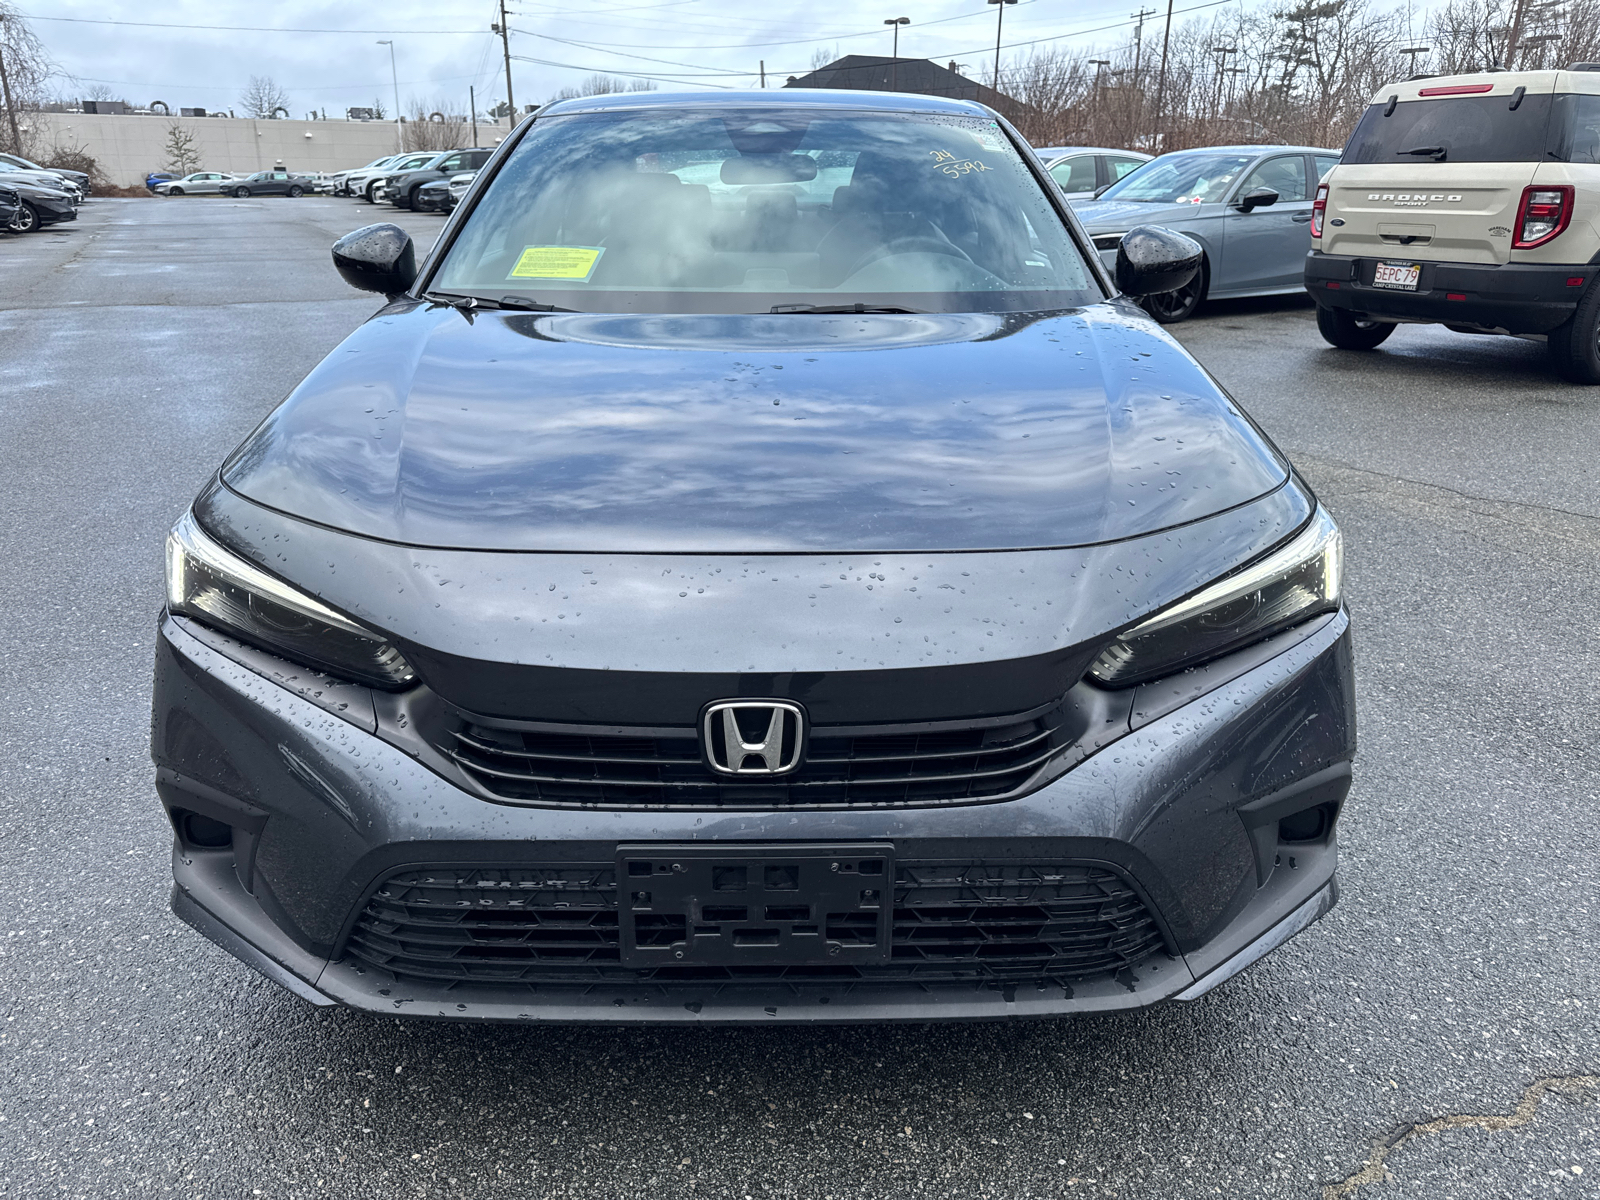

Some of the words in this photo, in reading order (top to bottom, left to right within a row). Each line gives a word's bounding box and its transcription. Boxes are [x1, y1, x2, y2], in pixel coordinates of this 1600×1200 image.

[929, 149, 955, 162] 24
[942, 160, 994, 179] 5592
[1368, 194, 1463, 202] BRONCO
[1376, 267, 1402, 282] 5EPC
[1404, 270, 1418, 282] 79
